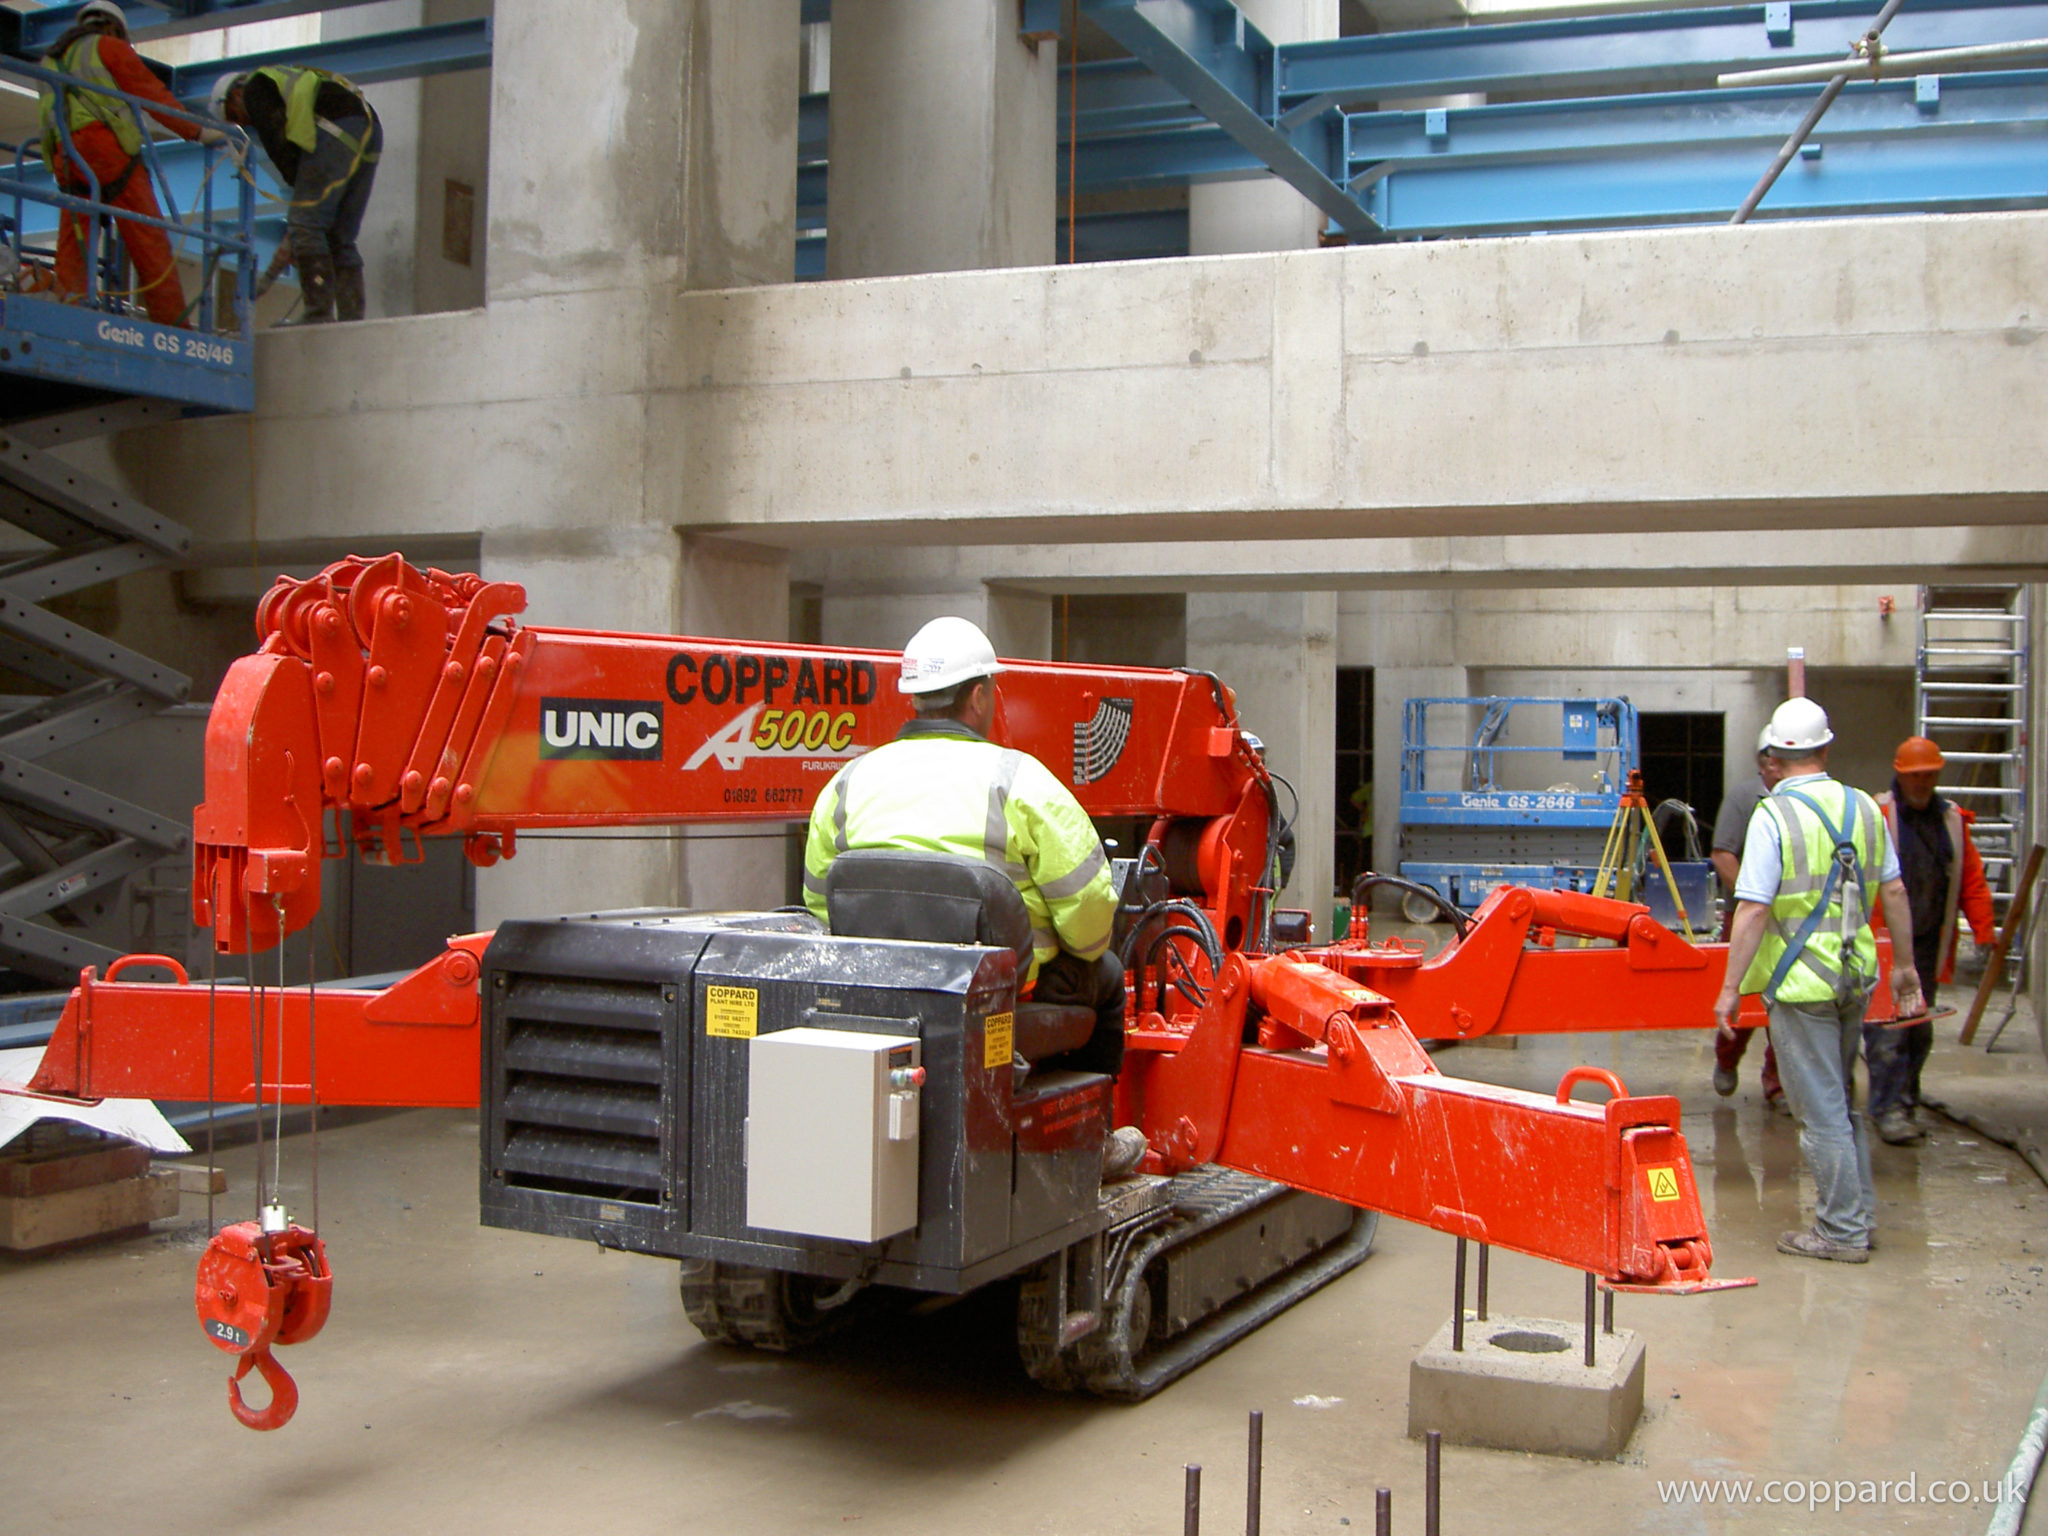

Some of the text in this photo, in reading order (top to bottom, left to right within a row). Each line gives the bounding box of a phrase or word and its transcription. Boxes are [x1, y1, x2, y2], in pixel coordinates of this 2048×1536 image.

[97, 320, 233, 365] Genie GS 26/46
[666, 653, 877, 705] COPPARD
[544, 710, 660, 749] UNIC
[754, 709, 857, 751] 500C
[724, 788, 757, 803] 01892
[1461, 793, 1576, 809] Genie GS-2646
[710, 988, 755, 1000] COPPARD
[216, 1323, 240, 1343] 2.9 t
